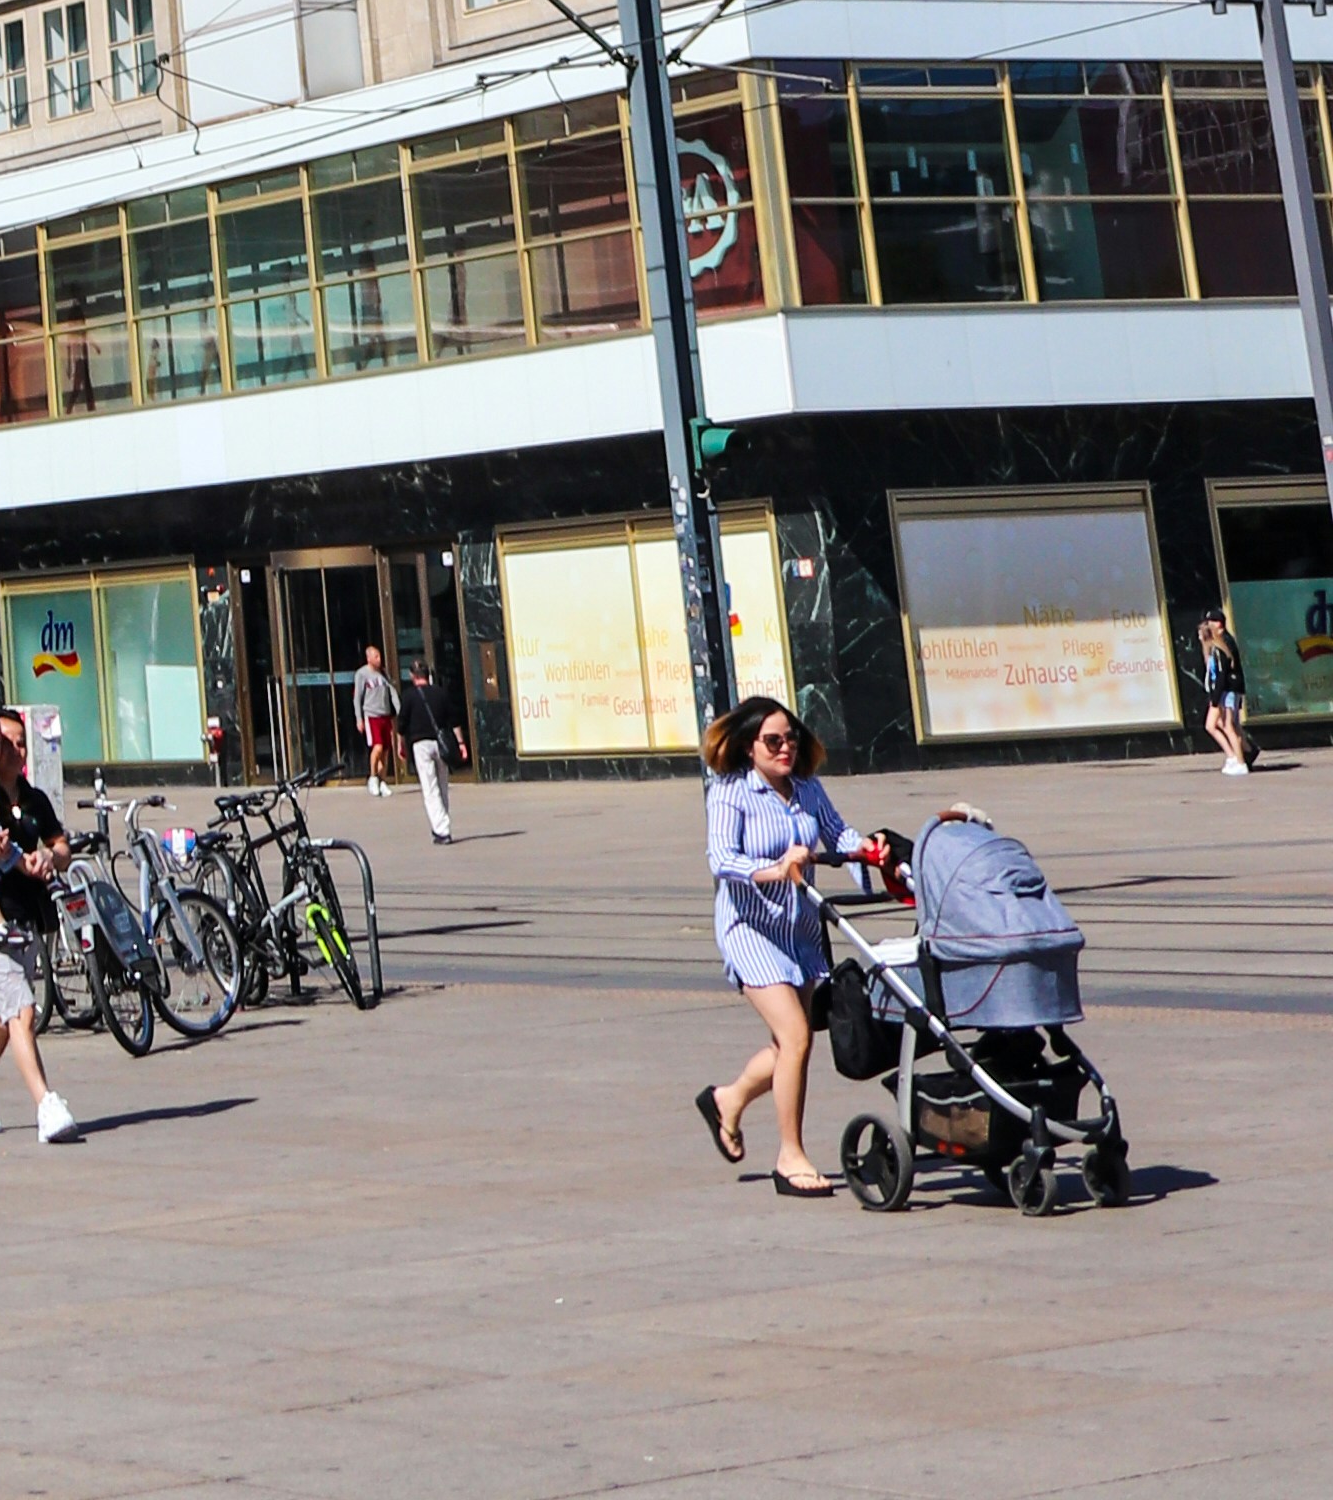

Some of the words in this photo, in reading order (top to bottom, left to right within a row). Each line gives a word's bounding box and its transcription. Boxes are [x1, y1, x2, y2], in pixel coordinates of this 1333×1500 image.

[1023, 605, 1076, 630] Nähe
[1111, 609, 1148, 629] Foto
[41, 610, 75, 653] dm
[1062, 638, 1104, 660] Pflege
[544, 660, 612, 682] Wohlfühlen
[657, 660, 692, 684] Pfleg
[1004, 661, 1078, 686] Zuhause
[522, 694, 551, 719] Duft
